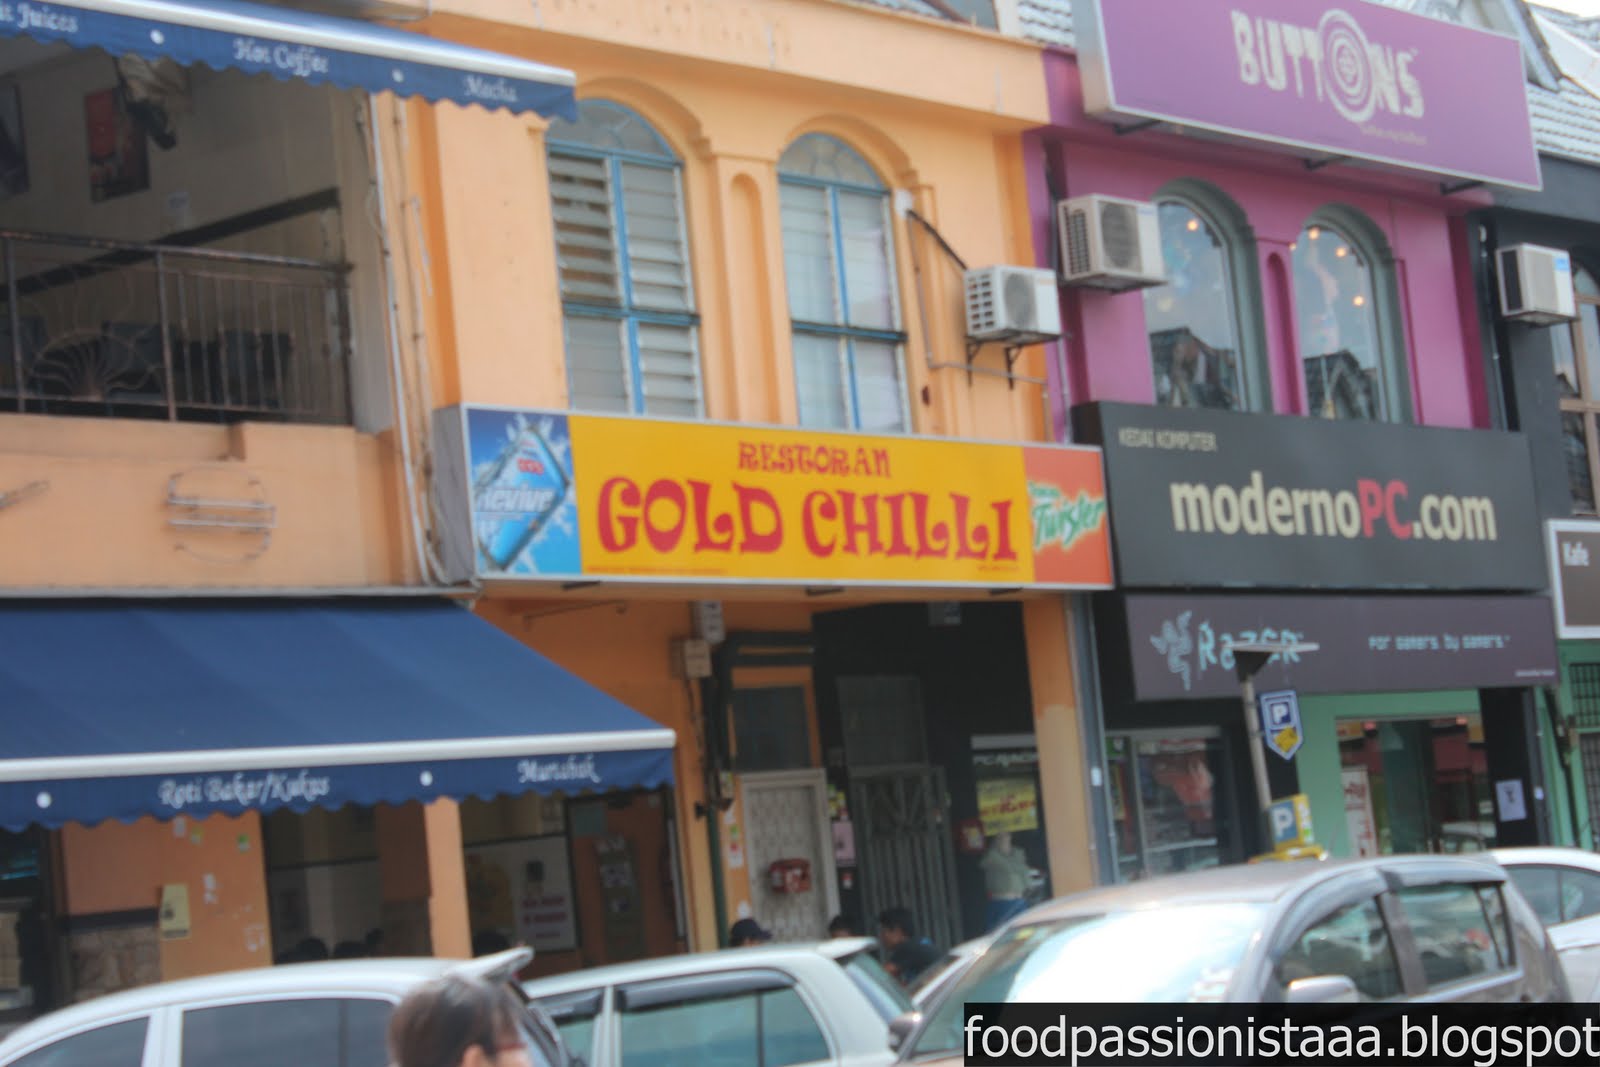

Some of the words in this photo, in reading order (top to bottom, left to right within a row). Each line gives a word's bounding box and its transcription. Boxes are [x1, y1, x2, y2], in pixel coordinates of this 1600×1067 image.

[273, 44, 329, 77] Coffee
[1231, 8, 1425, 123] BUTTONS
[738, 441, 890, 479] RESTORAN
[597, 476, 784, 554] GOLD
[802, 489, 1018, 561] CHILLI
[1169, 470, 1498, 541] modernoPC.com
